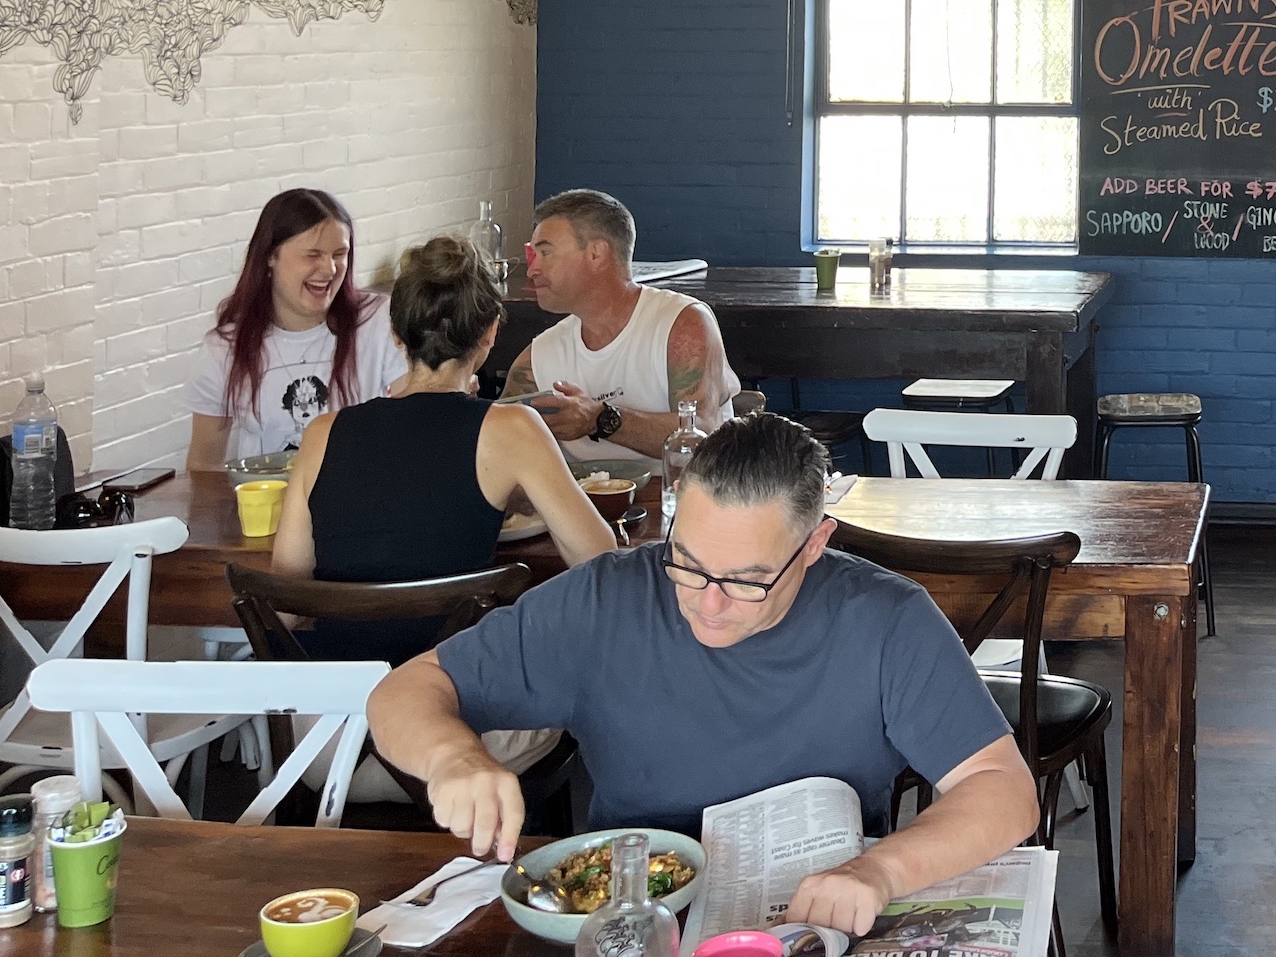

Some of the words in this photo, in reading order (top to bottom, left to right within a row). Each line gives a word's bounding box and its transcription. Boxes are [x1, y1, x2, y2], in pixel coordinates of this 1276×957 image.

[1100, 108, 1208, 155] Steamed
[1207, 98, 1263, 140] Rice
[1100, 177, 1138, 196] ADD
[1145, 178, 1194, 195] BEER
[1200, 180, 1233, 198] FOR
[1183, 201, 1229, 220] STONE
[1086, 210, 1163, 237] SAPPORO
[1193, 231, 1230, 251] WOOD
